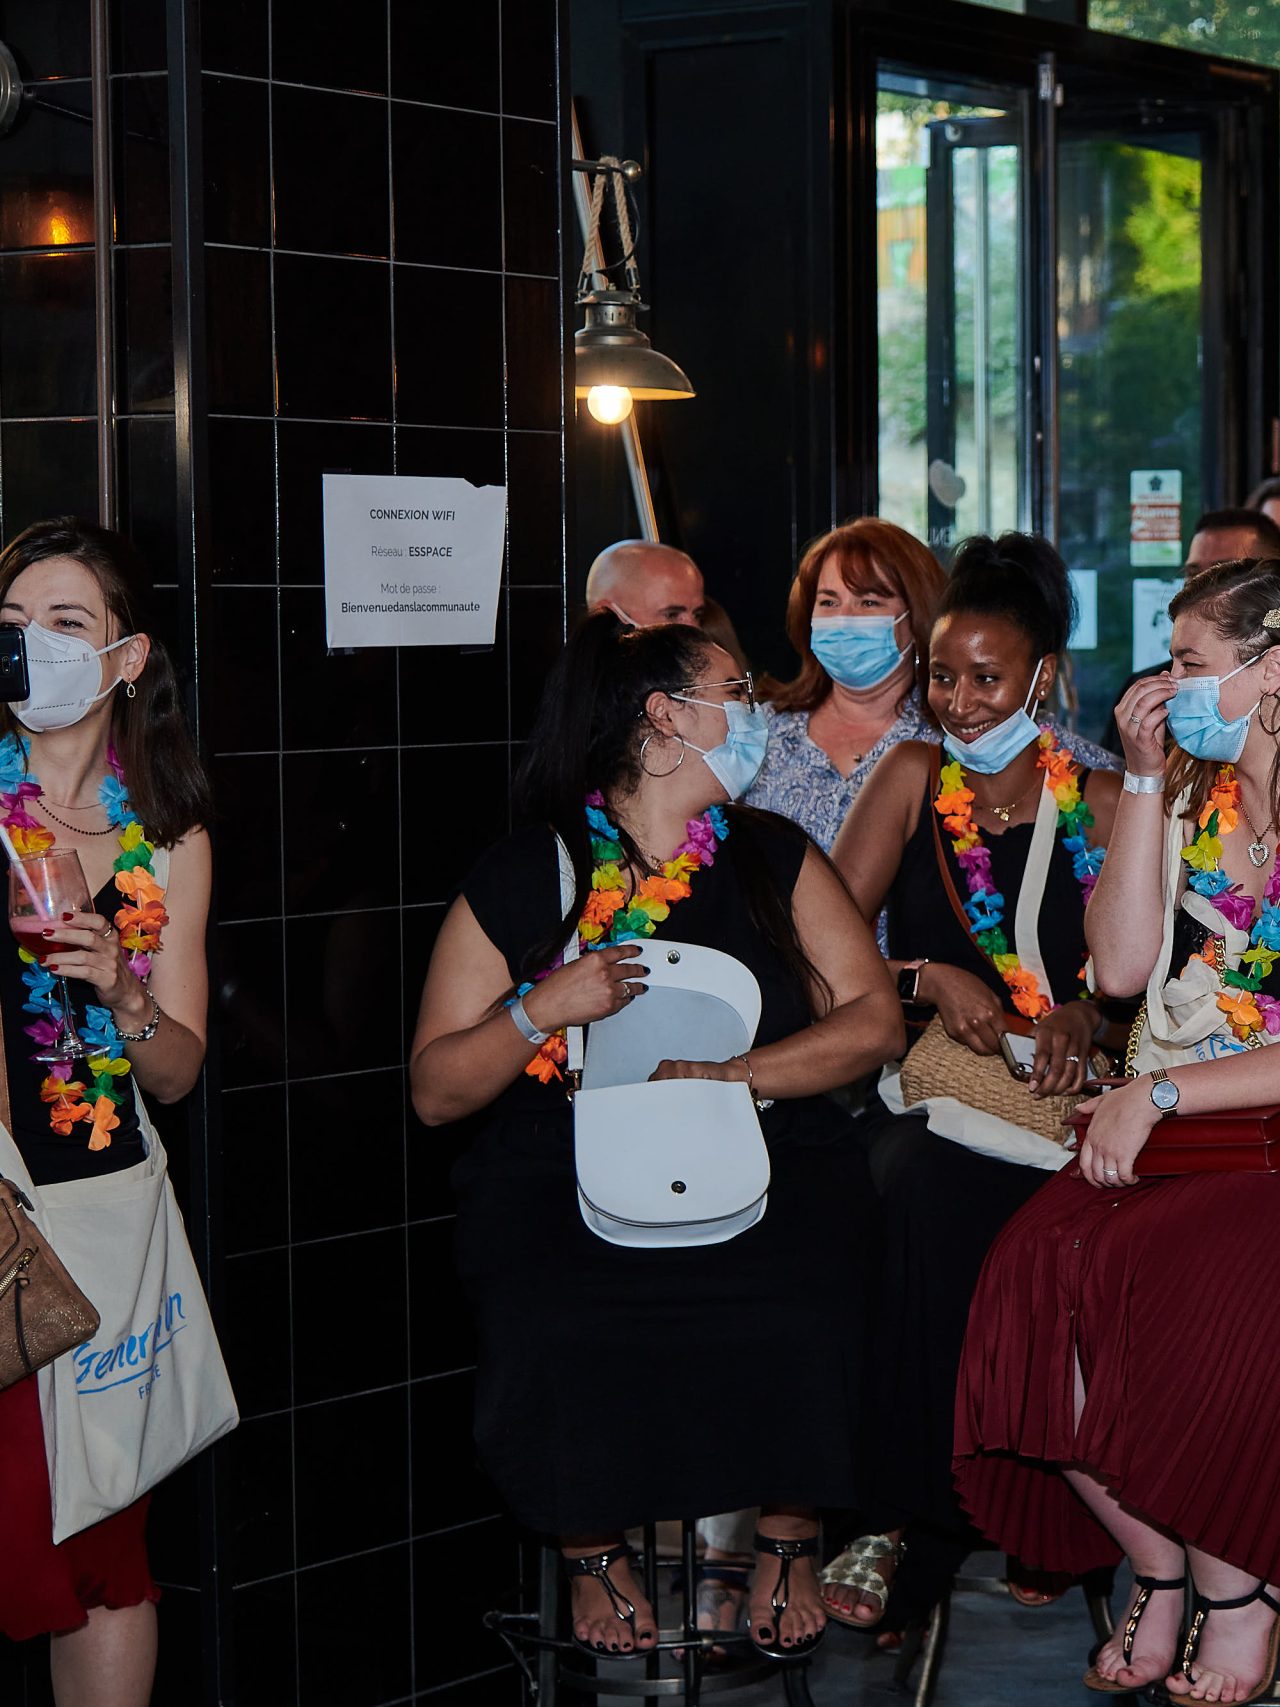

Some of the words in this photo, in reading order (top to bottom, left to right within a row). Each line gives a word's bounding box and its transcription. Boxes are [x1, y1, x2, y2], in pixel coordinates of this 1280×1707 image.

[369, 509, 429, 520] CONNEXION
[431, 510, 456, 521] WIFI
[408, 546, 453, 557] ESSPACE
[380, 583, 398, 594] Mot
[399, 583, 411, 594] de
[412, 585, 437, 596] passe
[341, 602, 480, 613] Bienvenuedanslacommunaute
